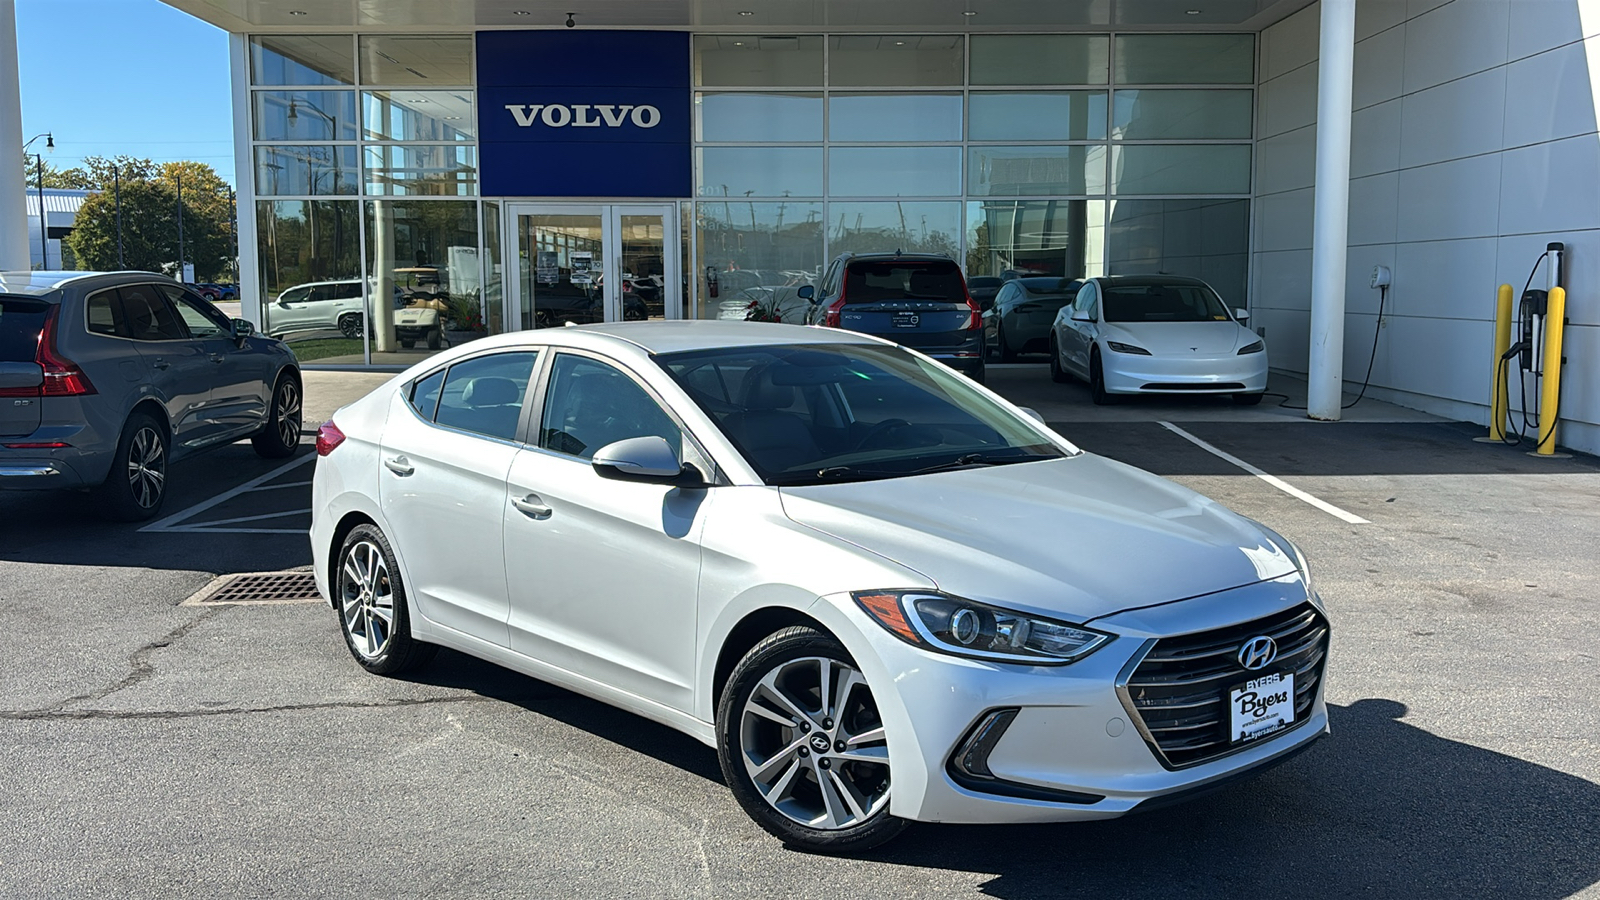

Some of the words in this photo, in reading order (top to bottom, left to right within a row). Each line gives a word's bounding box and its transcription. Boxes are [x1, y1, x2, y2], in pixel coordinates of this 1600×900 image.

[505, 104, 661, 128] VOLVO
[1247, 673, 1280, 690] BYERS
[1234, 691, 1288, 718] Byers
